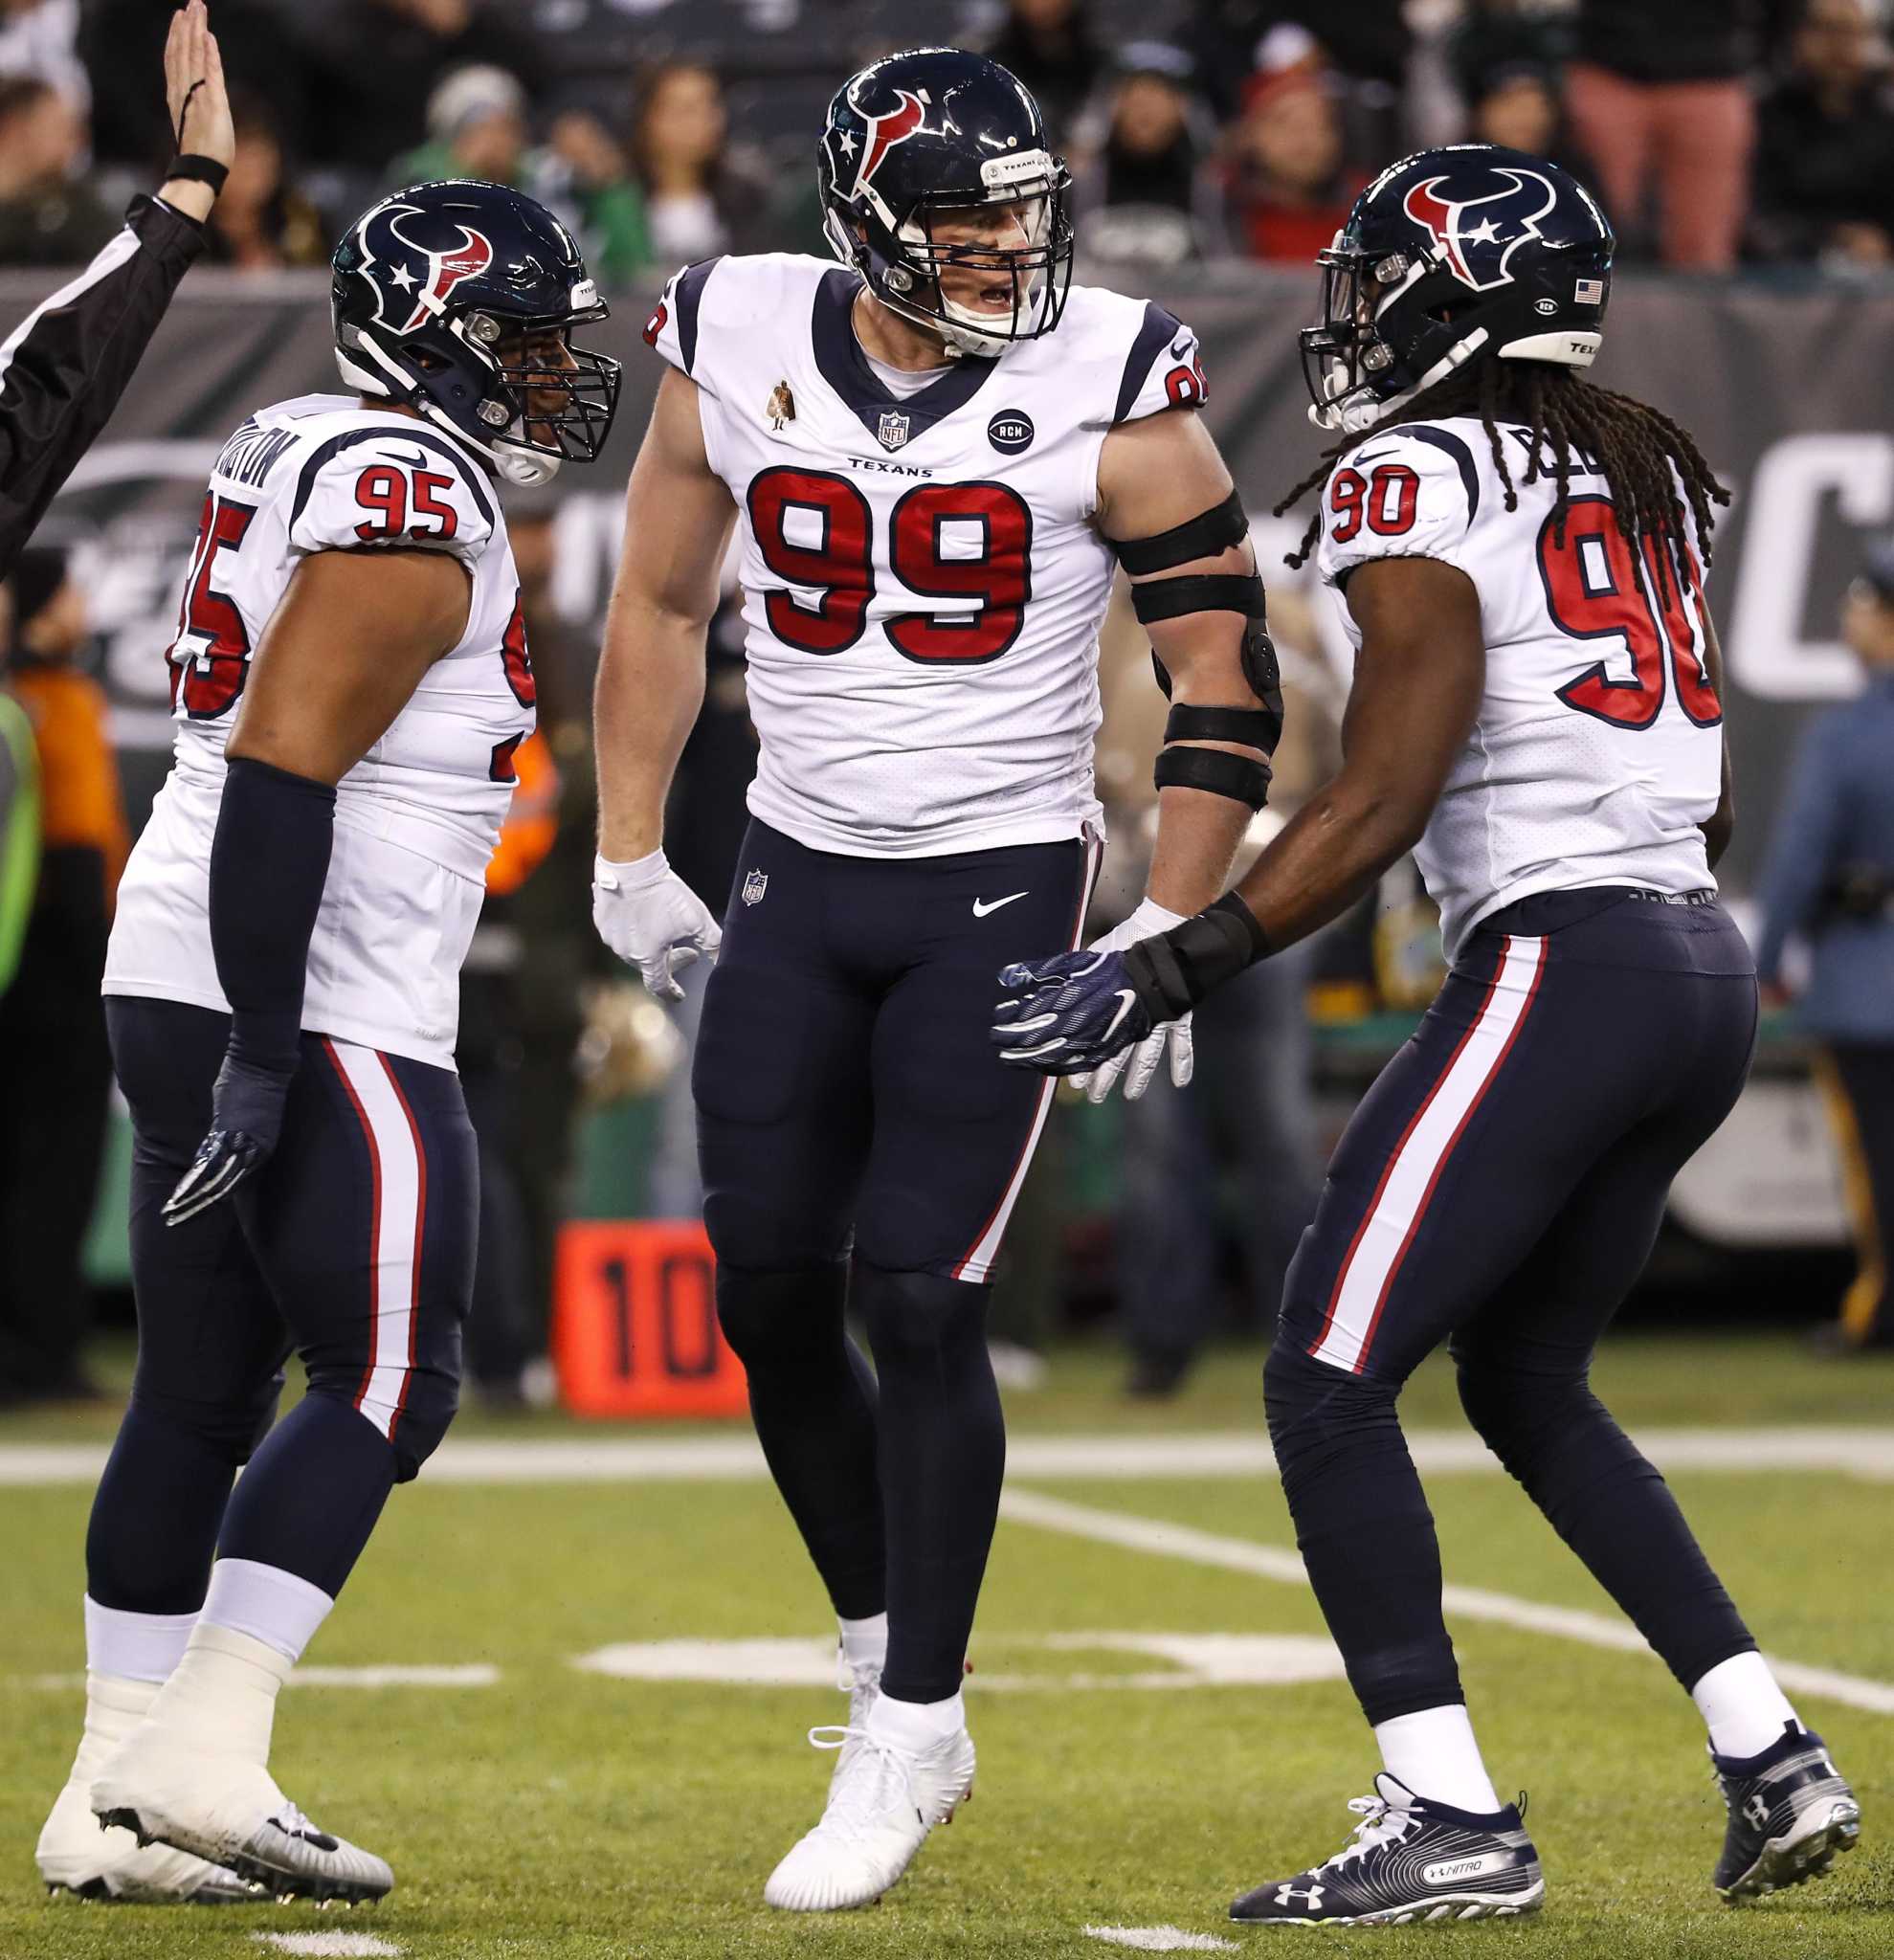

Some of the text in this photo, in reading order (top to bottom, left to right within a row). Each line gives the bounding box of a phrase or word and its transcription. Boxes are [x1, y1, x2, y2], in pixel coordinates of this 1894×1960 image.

[1003, 160, 1036, 170] TEXANS
[848, 457, 933, 479] TEXANS
[999, 426, 1023, 437] RCM
[353, 463, 458, 542] 95
[1331, 464, 1420, 544] 90
[746, 465, 1033, 666] 99
[165, 490, 258, 721] 5
[603, 1255, 720, 1381] 10
[1446, 1860, 1482, 1876] NITRO
